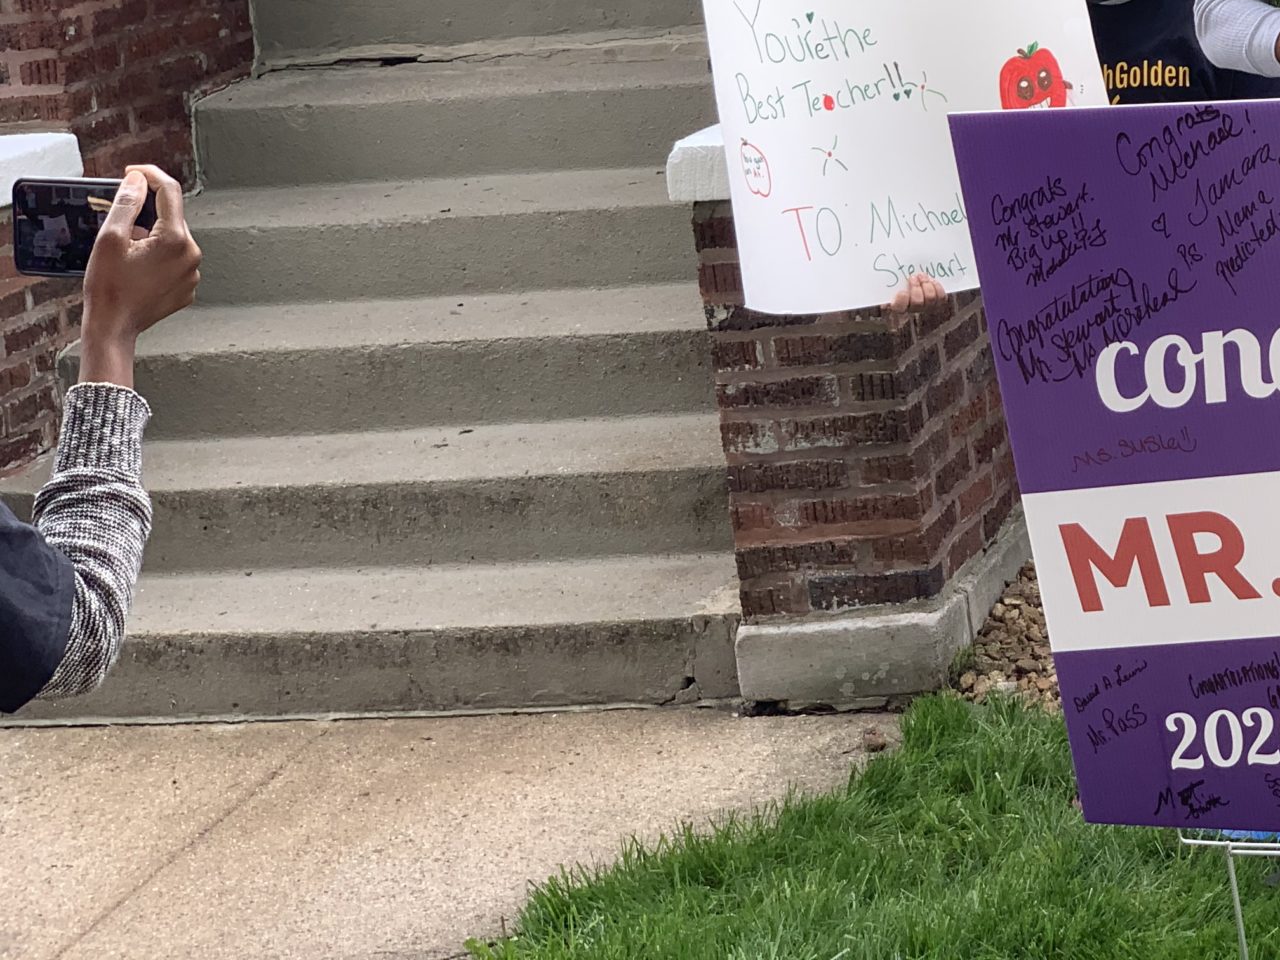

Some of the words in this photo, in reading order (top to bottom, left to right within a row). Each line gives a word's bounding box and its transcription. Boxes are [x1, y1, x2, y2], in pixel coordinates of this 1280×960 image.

[825, 19, 879, 62] the
[1103, 59, 1190, 90] hGolden
[735, 73, 786, 125] Best
[869, 191, 968, 244] Michael
[873, 252, 968, 288] Stewart
